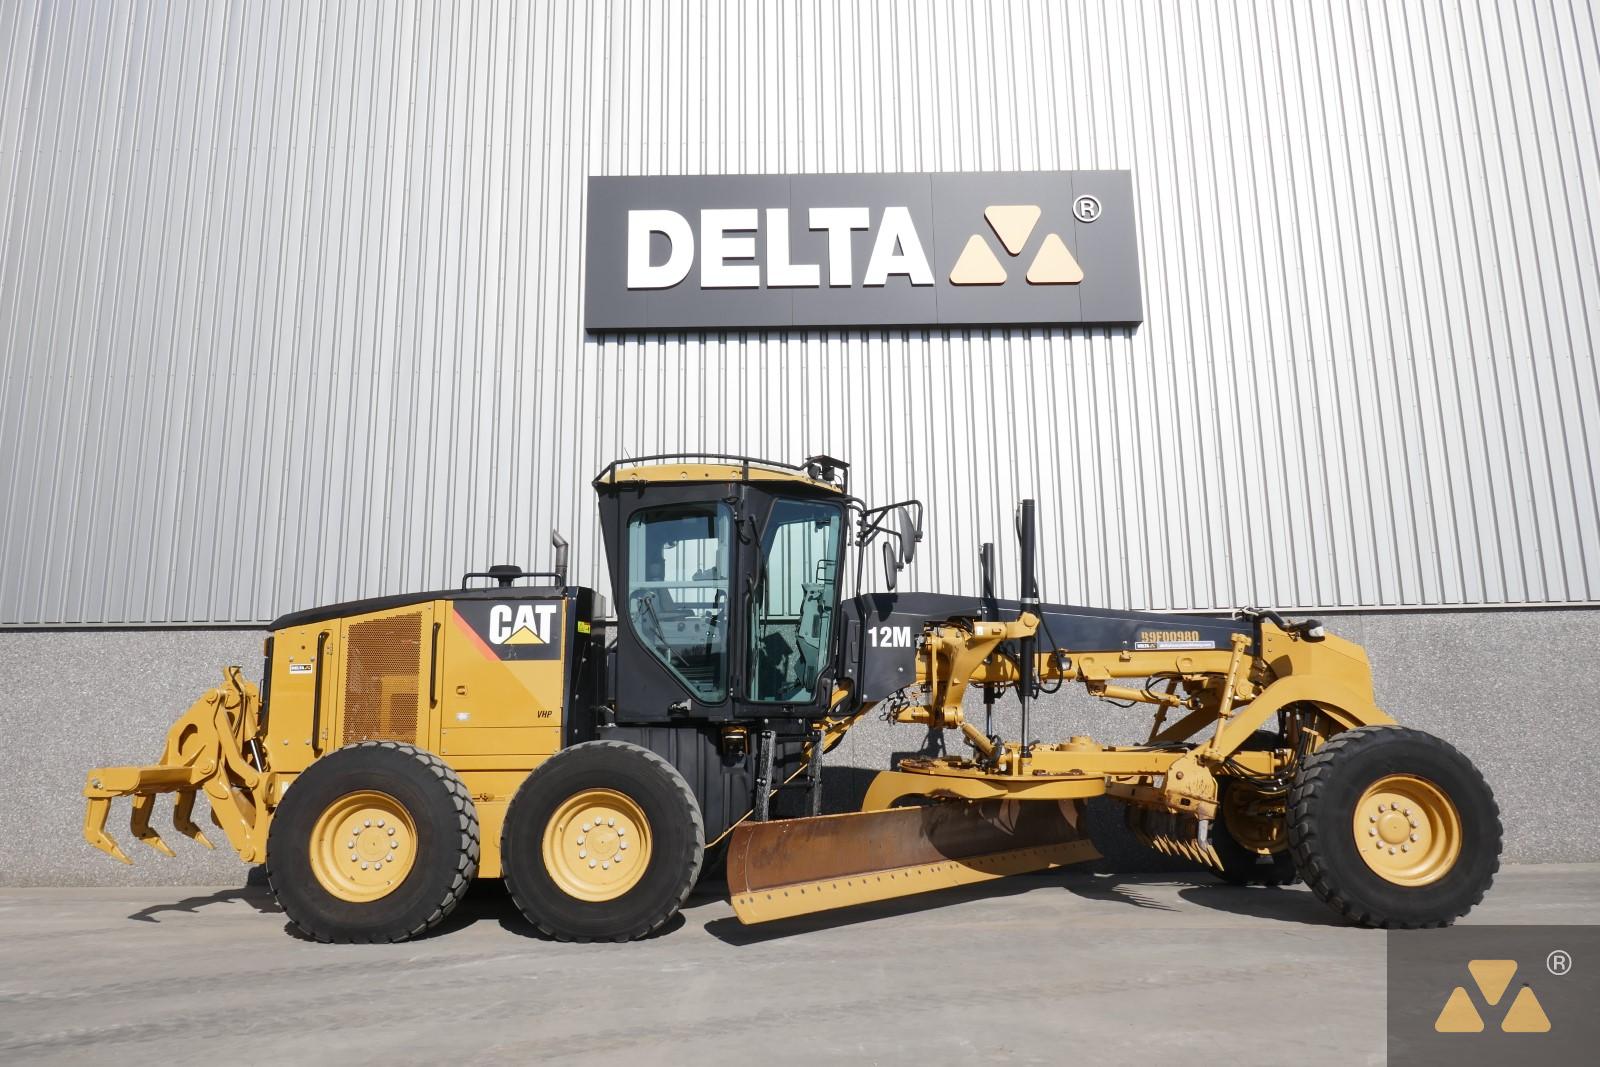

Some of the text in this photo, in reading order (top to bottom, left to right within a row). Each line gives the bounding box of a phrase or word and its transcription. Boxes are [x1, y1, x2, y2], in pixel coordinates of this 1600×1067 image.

[627, 206, 935, 290] DELTA
[489, 604, 557, 645] CAT
[868, 626, 911, 648] 12M
[537, 710, 553, 719] VHP
